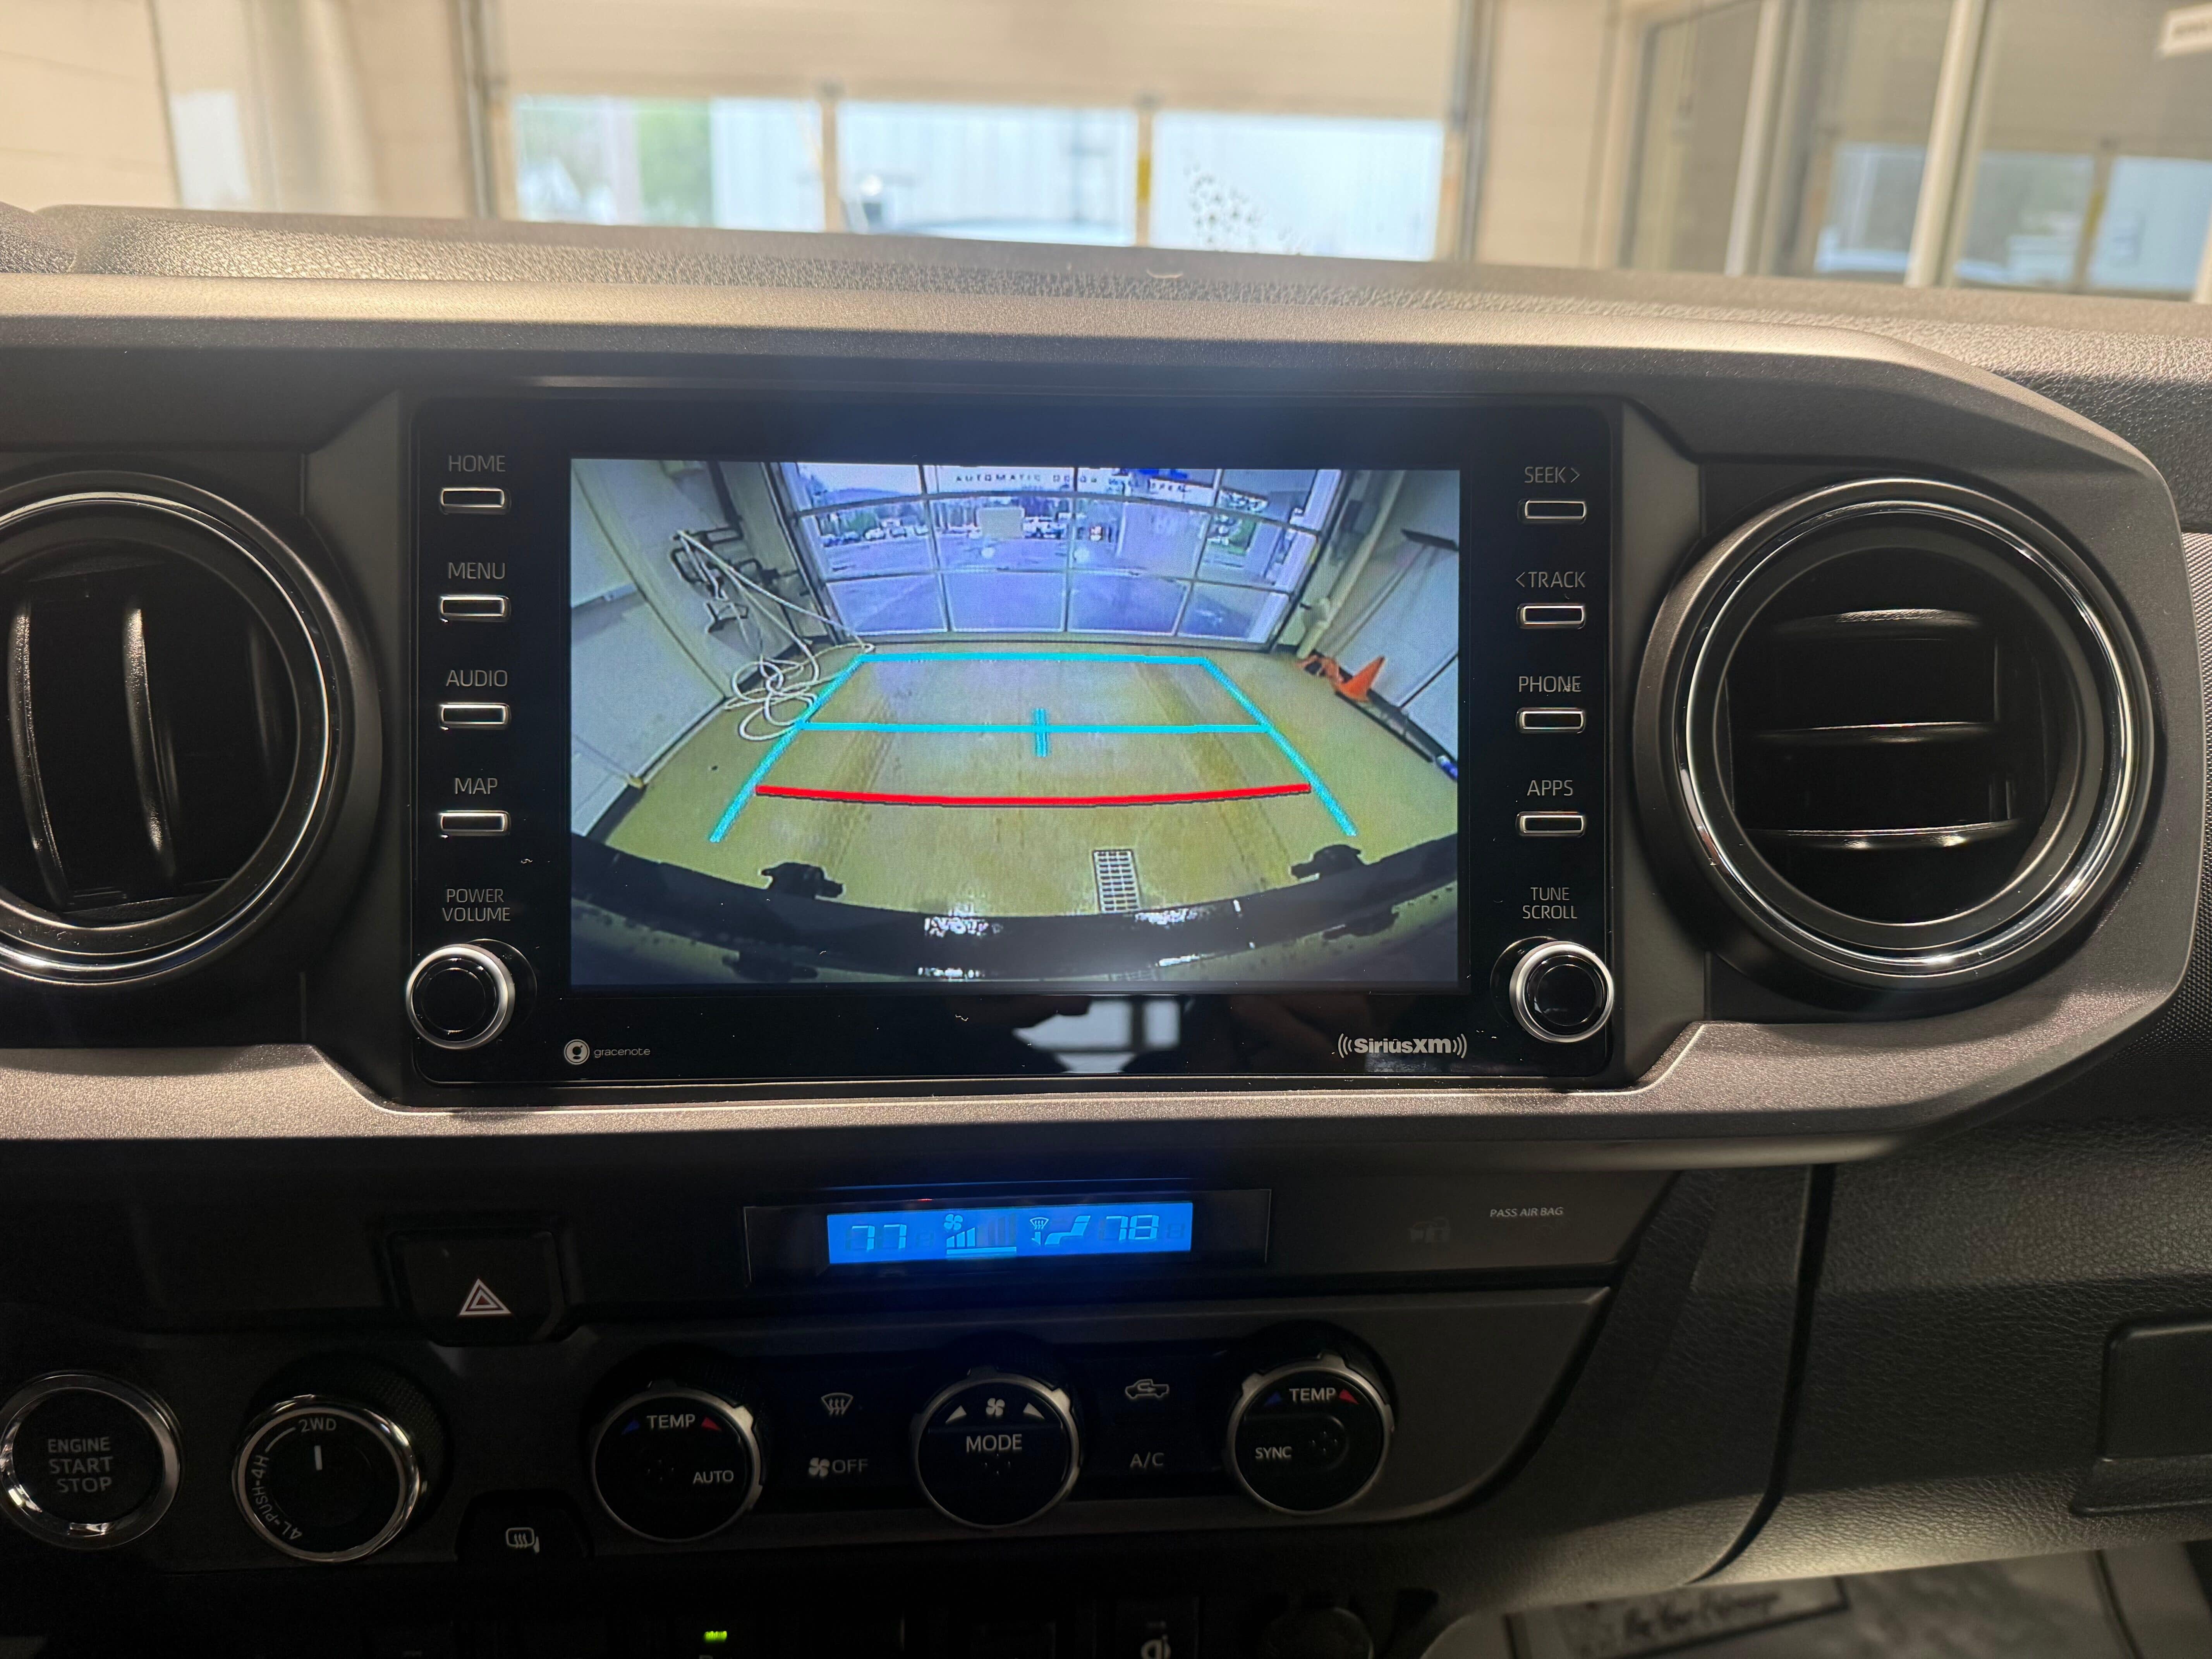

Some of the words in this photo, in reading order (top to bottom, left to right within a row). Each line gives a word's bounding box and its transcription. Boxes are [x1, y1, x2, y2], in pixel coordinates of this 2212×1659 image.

[449, 455, 506, 472] HOME
[448, 562, 505, 579] MENU
[446, 670, 508, 687] AUDIO
[1519, 676, 1581, 692] PHONE
[455, 778, 498, 794] MAP
[1527, 780, 1573, 796] APPS
[447, 888, 504, 903] POWER
[1530, 887, 1570, 901] TUNE
[442, 907, 510, 922] VOLUME
[1523, 905, 1578, 919] SCROLL
[594, 1048, 651, 1058] gracenote
[1490, 1208, 1518, 1217] PASS
[1519, 1208, 1538, 1216] AIR
[1540, 1207, 1564, 1216] BAG
[1106, 1215, 1159, 1241] 78
[852, 1224, 907, 1250] 77
[1289, 1388, 1336, 1401] TEMP
[299, 1417, 337, 1432] 2WD
[647, 1414, 695, 1429] TEMP
[48, 1436, 110, 1453] ENGINE
[966, 1434, 1022, 1452] MODE
[1130, 1452, 1164, 1468] A/C
[1255, 1446, 1291, 1459] SYNC
[49, 1456, 113, 1474] START
[832, 1459, 867, 1473] OFF
[57, 1477, 112, 1493] STOP
[693, 1470, 734, 1484] AUTO
